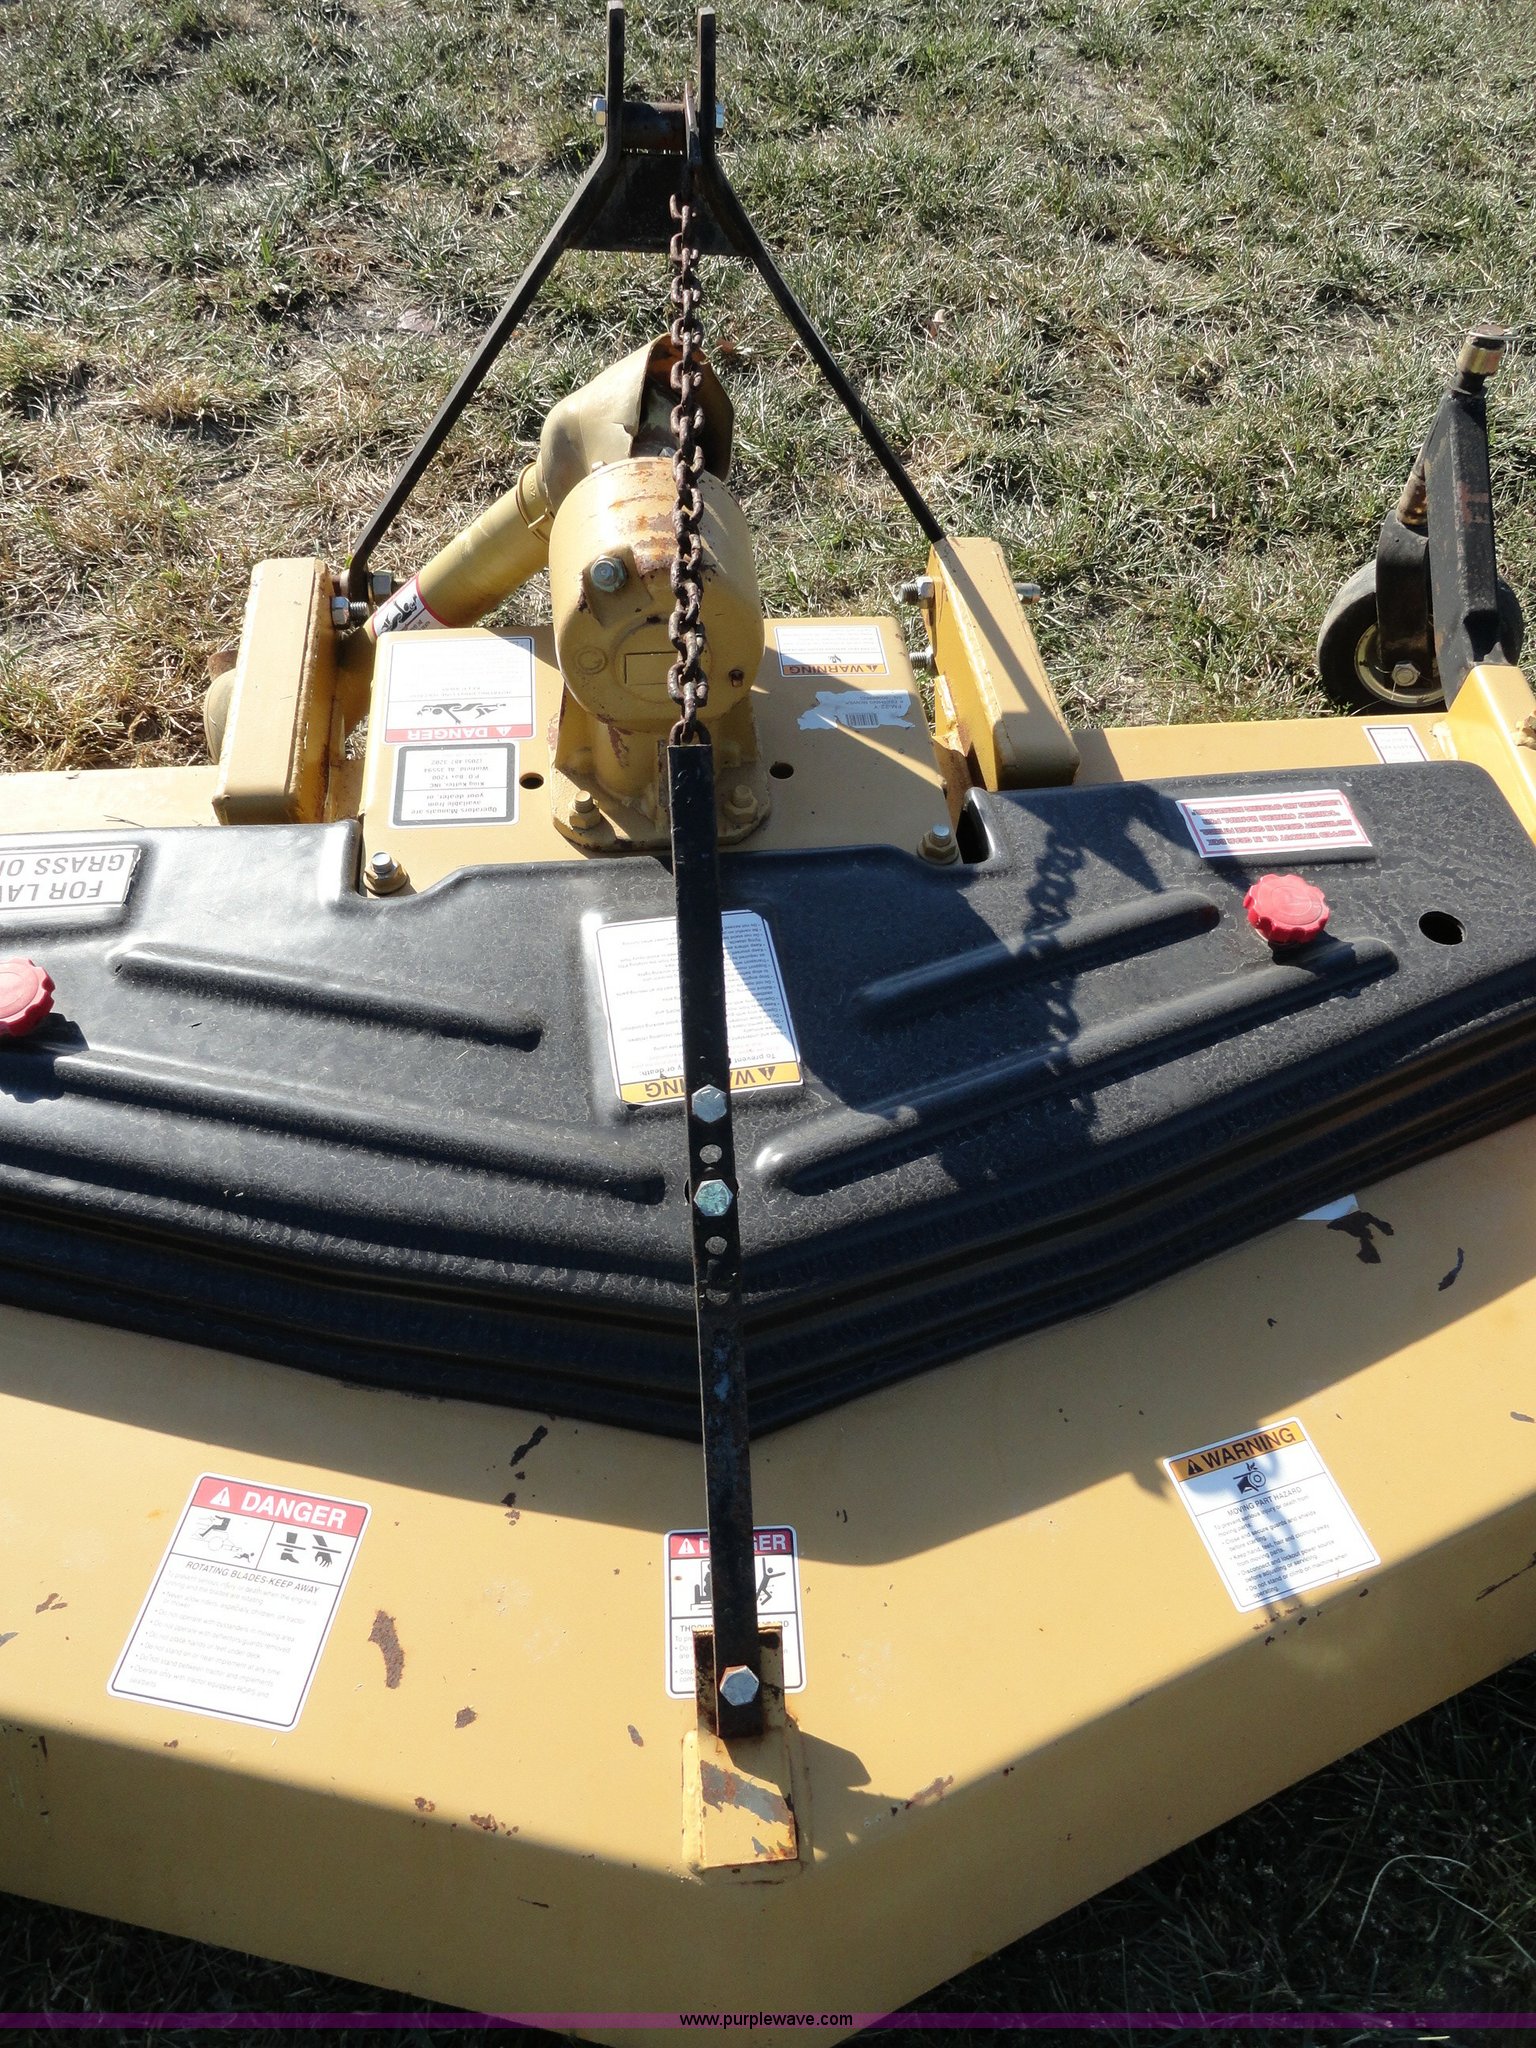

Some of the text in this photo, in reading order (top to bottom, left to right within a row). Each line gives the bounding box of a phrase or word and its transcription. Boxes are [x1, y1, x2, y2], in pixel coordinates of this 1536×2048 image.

[790, 666, 863, 674] WARNING
[407, 727, 487, 740] DANGER
[0, 854, 125, 877] GRASS O
[0, 880, 104, 902] FOR LA
[733, 1053, 764, 1063] prevent
[643, 1068, 756, 1098] WING
[1200, 1426, 1296, 1469] WARNING
[239, 1491, 349, 1529] DANGER
[1226, 1486, 1302, 1516] MOVING PART HAZARD
[1250, 1525, 1269, 1536] secure
[1268, 1519, 1287, 1530] guards
[700, 1534, 786, 1554] DER
[1269, 1557, 1281, 1565] and
[184, 1561, 320, 1594] ROTATING BLADES-KEEP AWAY
